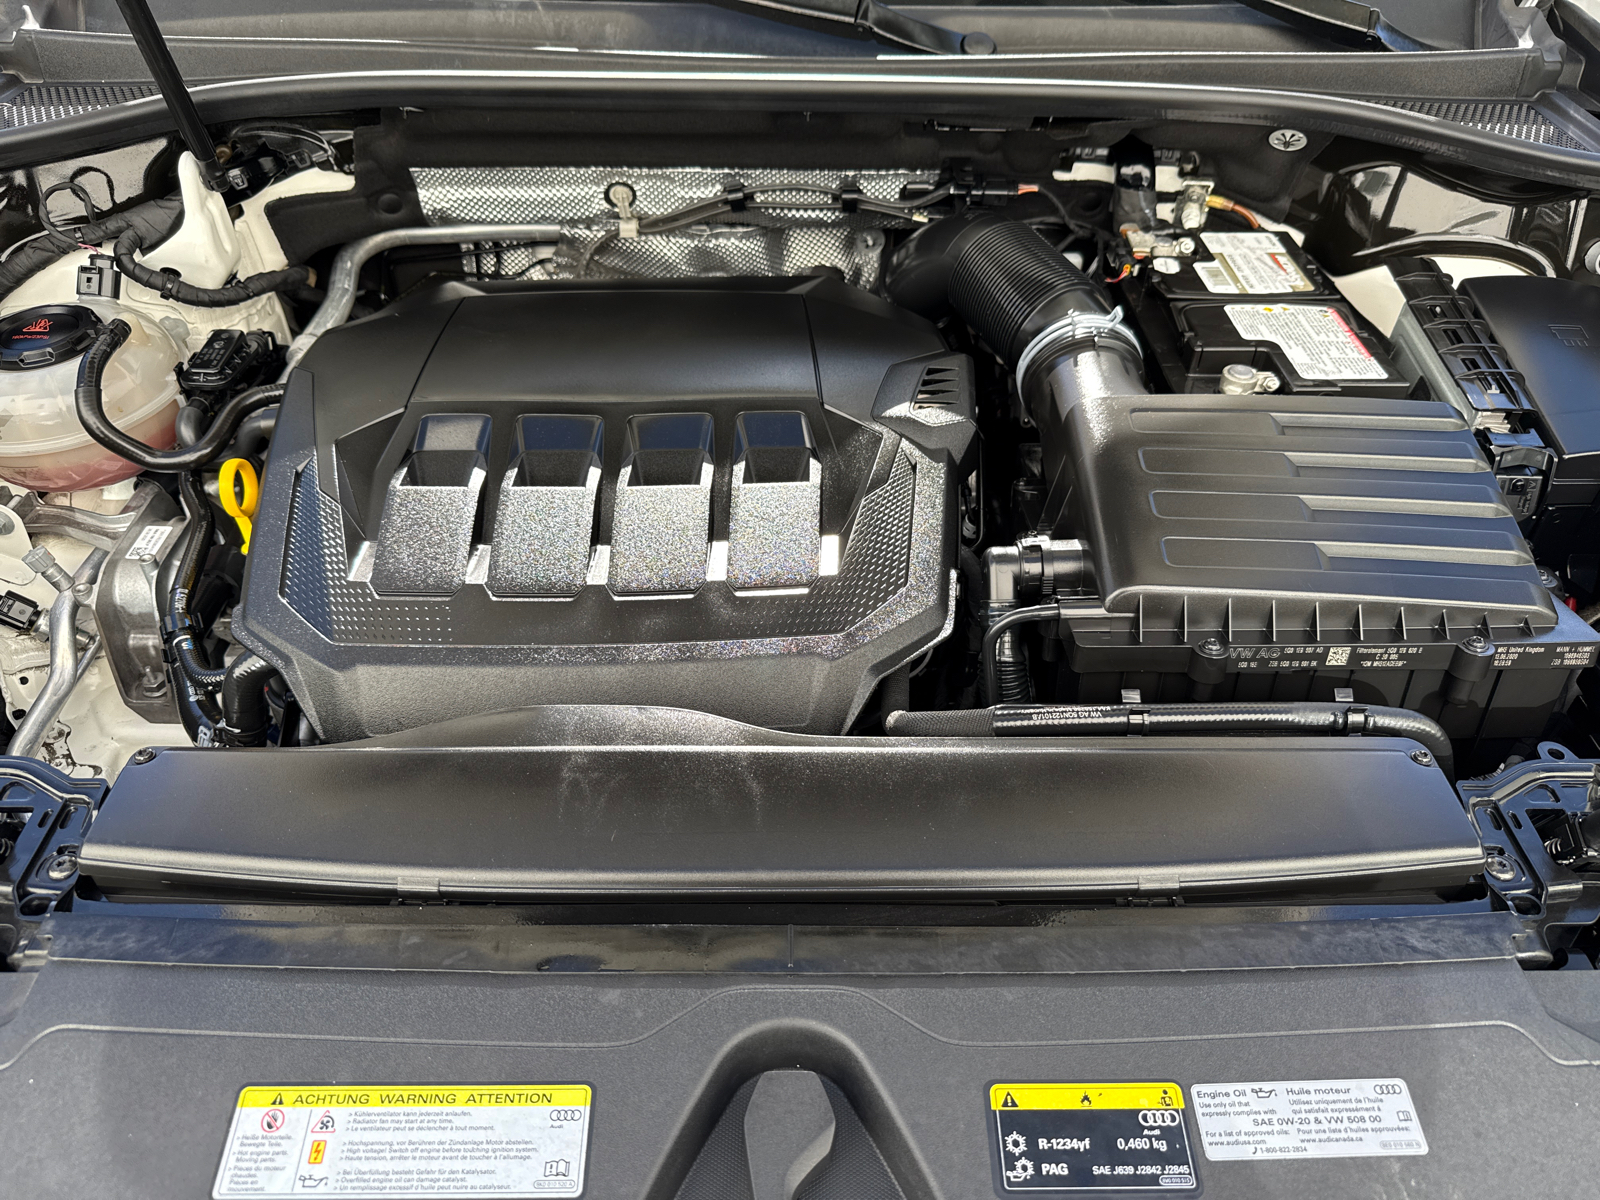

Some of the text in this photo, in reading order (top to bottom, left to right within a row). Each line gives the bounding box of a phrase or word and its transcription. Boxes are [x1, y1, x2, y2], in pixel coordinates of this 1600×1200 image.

[1229, 648, 1280, 658] VW AG
[292, 1093, 553, 1105] ACHTUNG WARNING ATTENTION
[1196, 1090, 1230, 1099] Engine
[1277, 1117, 1310, 1126] 0W-20
[1324, 1116, 1344, 1124] VW
[1038, 1138, 1167, 1152] R-1234yf 0,460 kg
[354, 1168, 390, 1176] Überfüllung
[1041, 1164, 1189, 1175] PAG SAE J639 J2842 J2845
